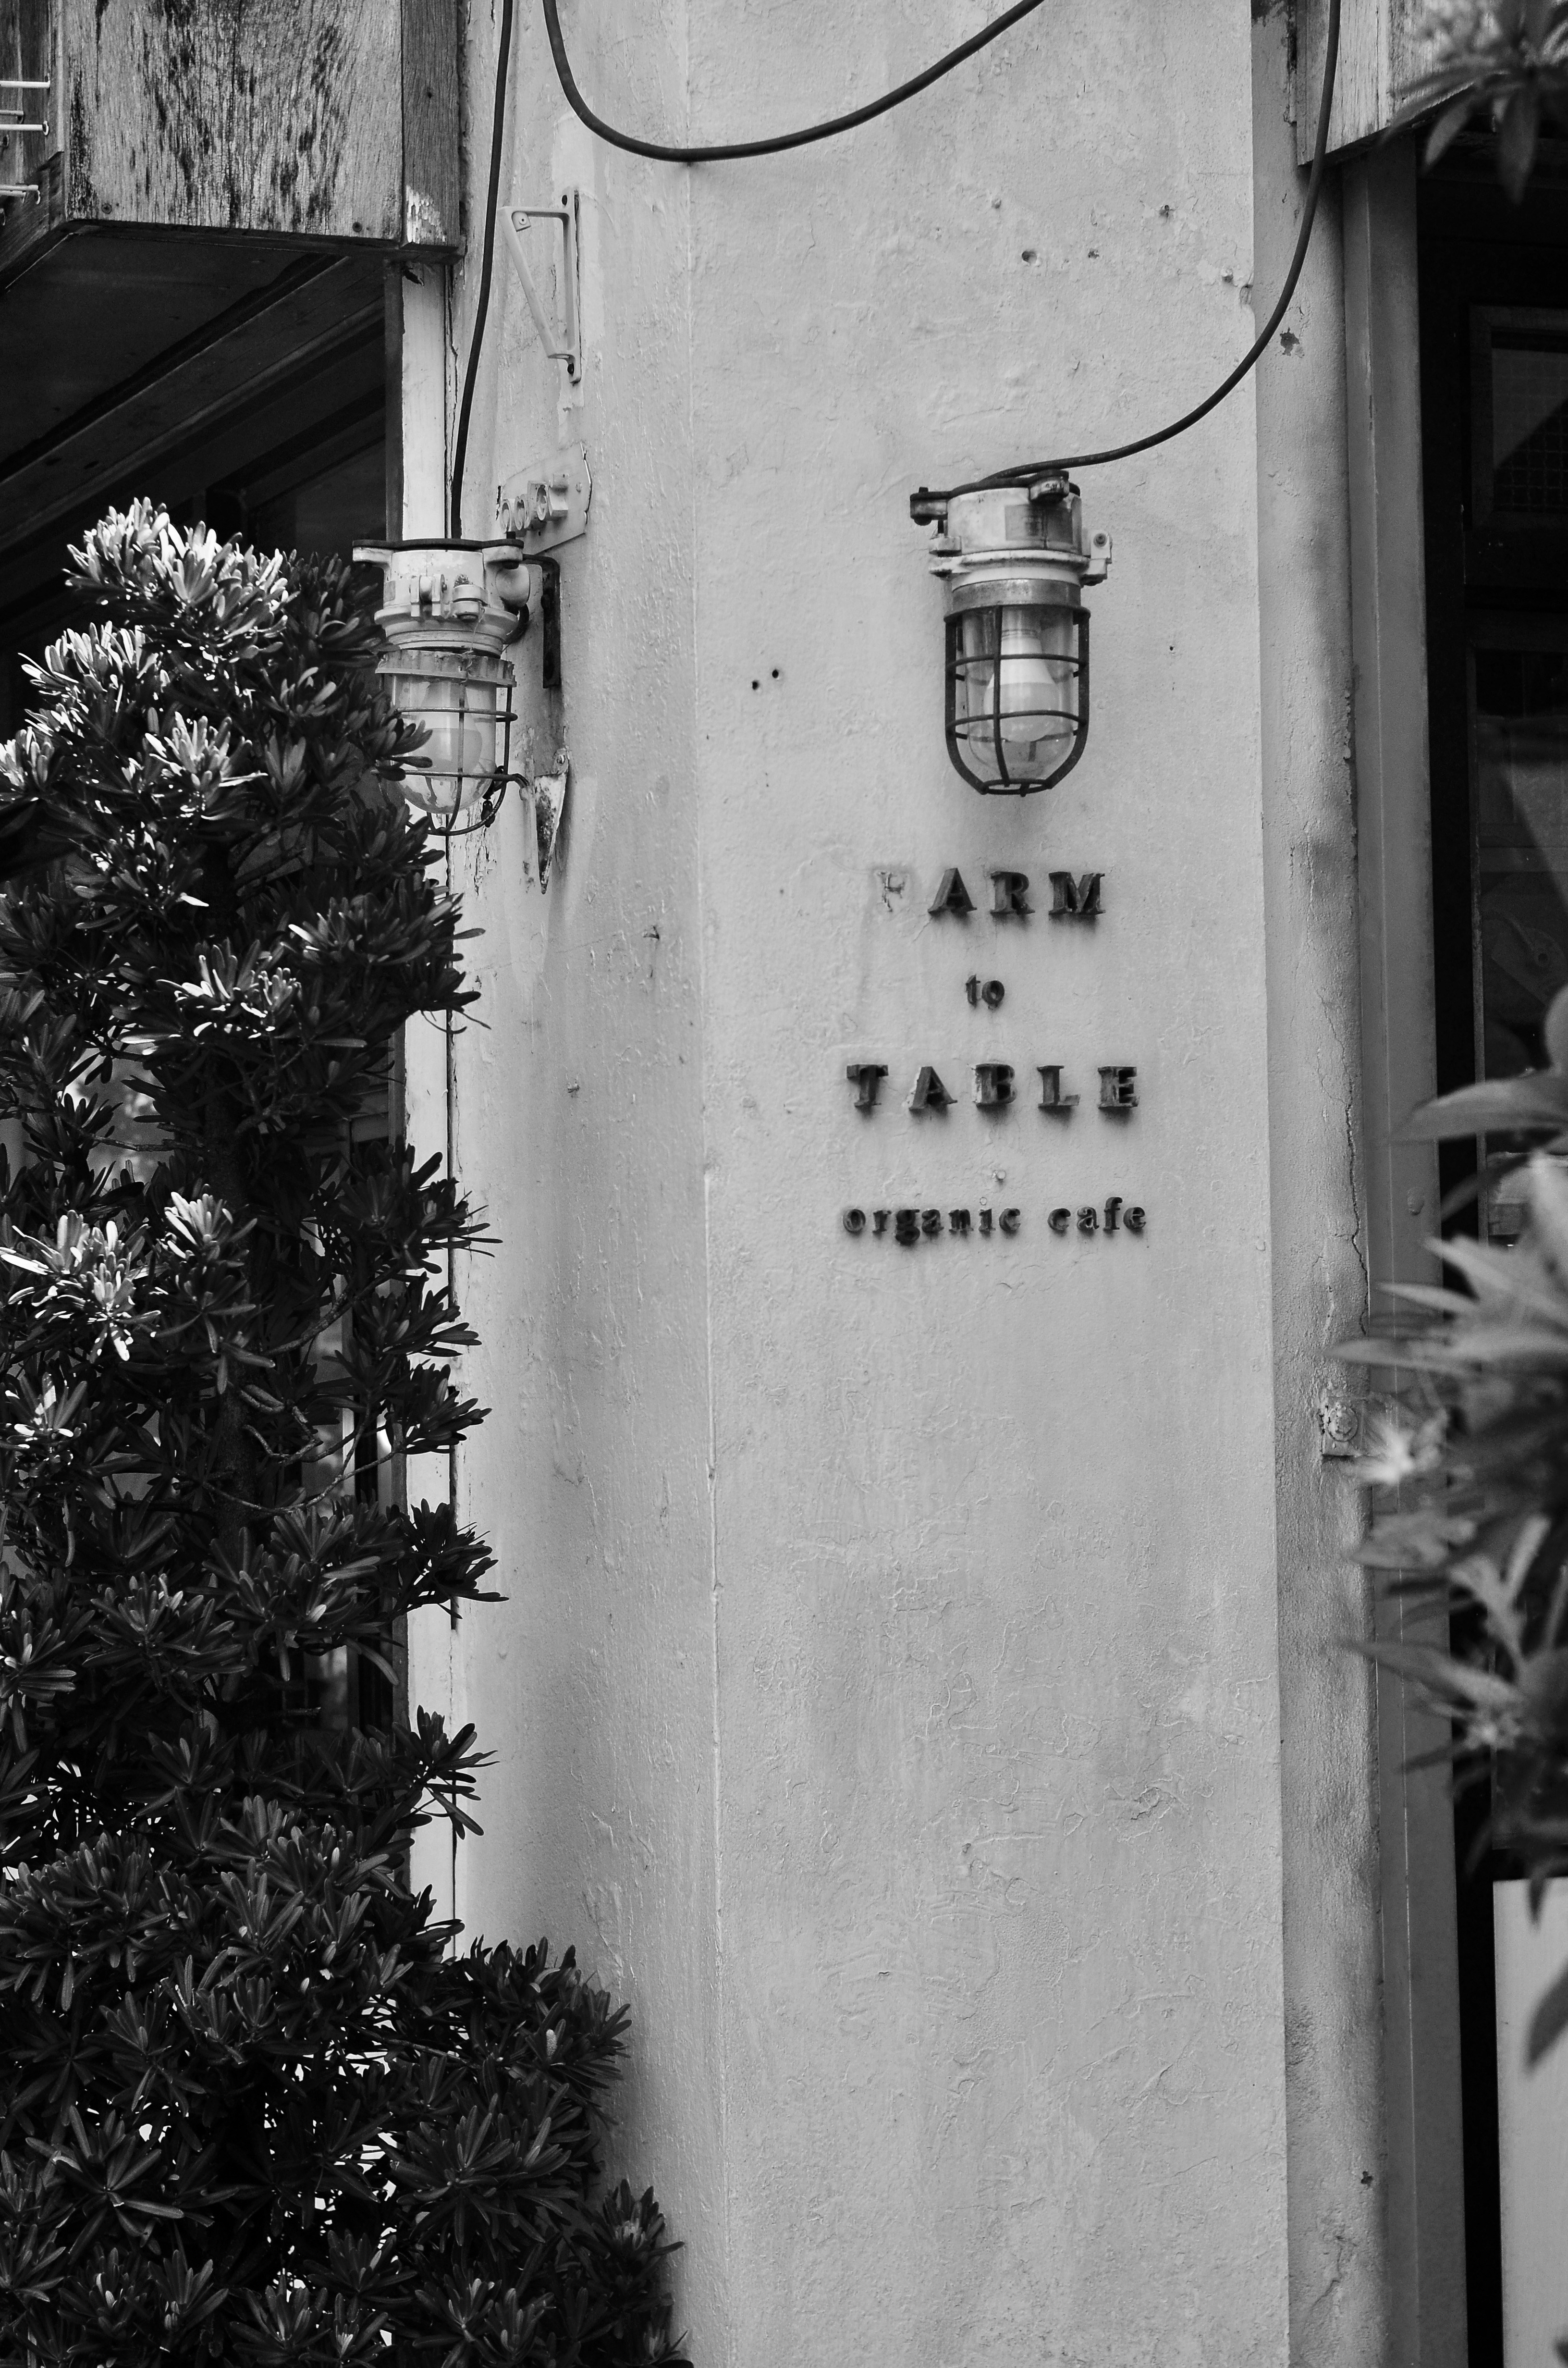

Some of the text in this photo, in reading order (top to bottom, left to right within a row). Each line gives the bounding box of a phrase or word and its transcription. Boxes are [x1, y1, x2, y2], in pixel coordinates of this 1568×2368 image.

[966, 974, 1005, 1008] to
[846, 1063, 1140, 1110] TABLE
[843, 1196, 1146, 1244] organic cafe
